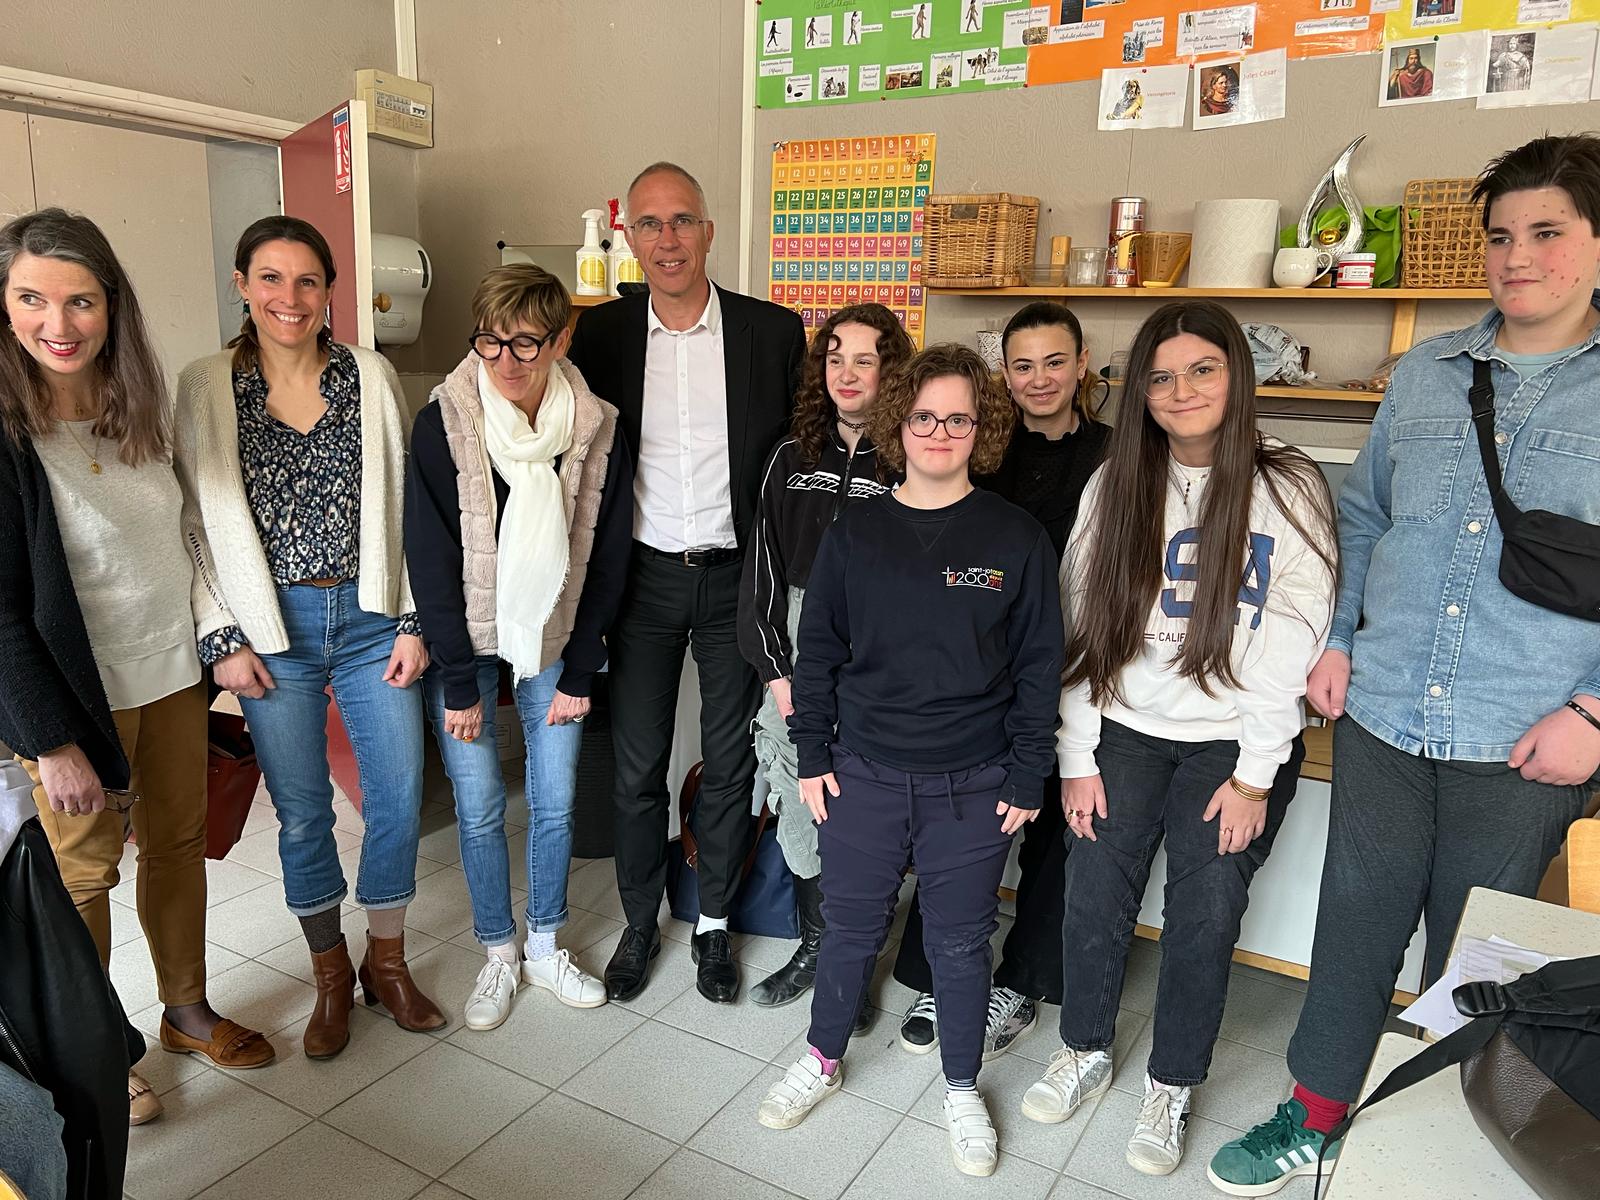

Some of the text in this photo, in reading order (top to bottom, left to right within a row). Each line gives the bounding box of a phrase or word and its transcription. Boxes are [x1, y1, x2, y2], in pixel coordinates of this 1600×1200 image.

[1243, 69, 1278, 80] Jules César
[794, 145, 799, 153] 2
[856, 142, 860, 150] 6
[872, 141, 877, 149] 7
[889, 140, 894, 148] 8
[905, 139, 910, 147] 9
[921, 138, 928, 146] 10
[823, 168, 830, 176] 14
[871, 166, 878, 174] 17
[887, 165, 894, 173] 18
[919, 164, 927, 172] 20
[791, 193, 799, 201] 22
[852, 191, 861, 199] 26
[884, 190, 893, 198] 28
[900, 190, 909, 198] 29
[917, 189, 926, 197] 30
[805, 216, 813, 224] 33
[820, 216, 828, 224] 34
[836, 216, 844, 224] 35
[867, 215, 875, 223] 37
[915, 214, 924, 222] 40
[914, 239, 922, 247] 50
[775, 264, 782, 272] 51
[790, 264, 797, 272] 52
[804, 264, 812, 272] 53
[834, 264, 842, 272] 55
[850, 264, 858, 272] 56
[881, 264, 890, 272] 58
[897, 264, 906, 272] 59
[833, 288, 841, 296] 65
[848, 288, 857, 296] 66
[864, 288, 872, 296] 67
[880, 288, 888, 296] 68
[910, 313, 919, 321] 80
[956, 571, 989, 586] 200
[1158, 632, 1186, 643] CALIF
